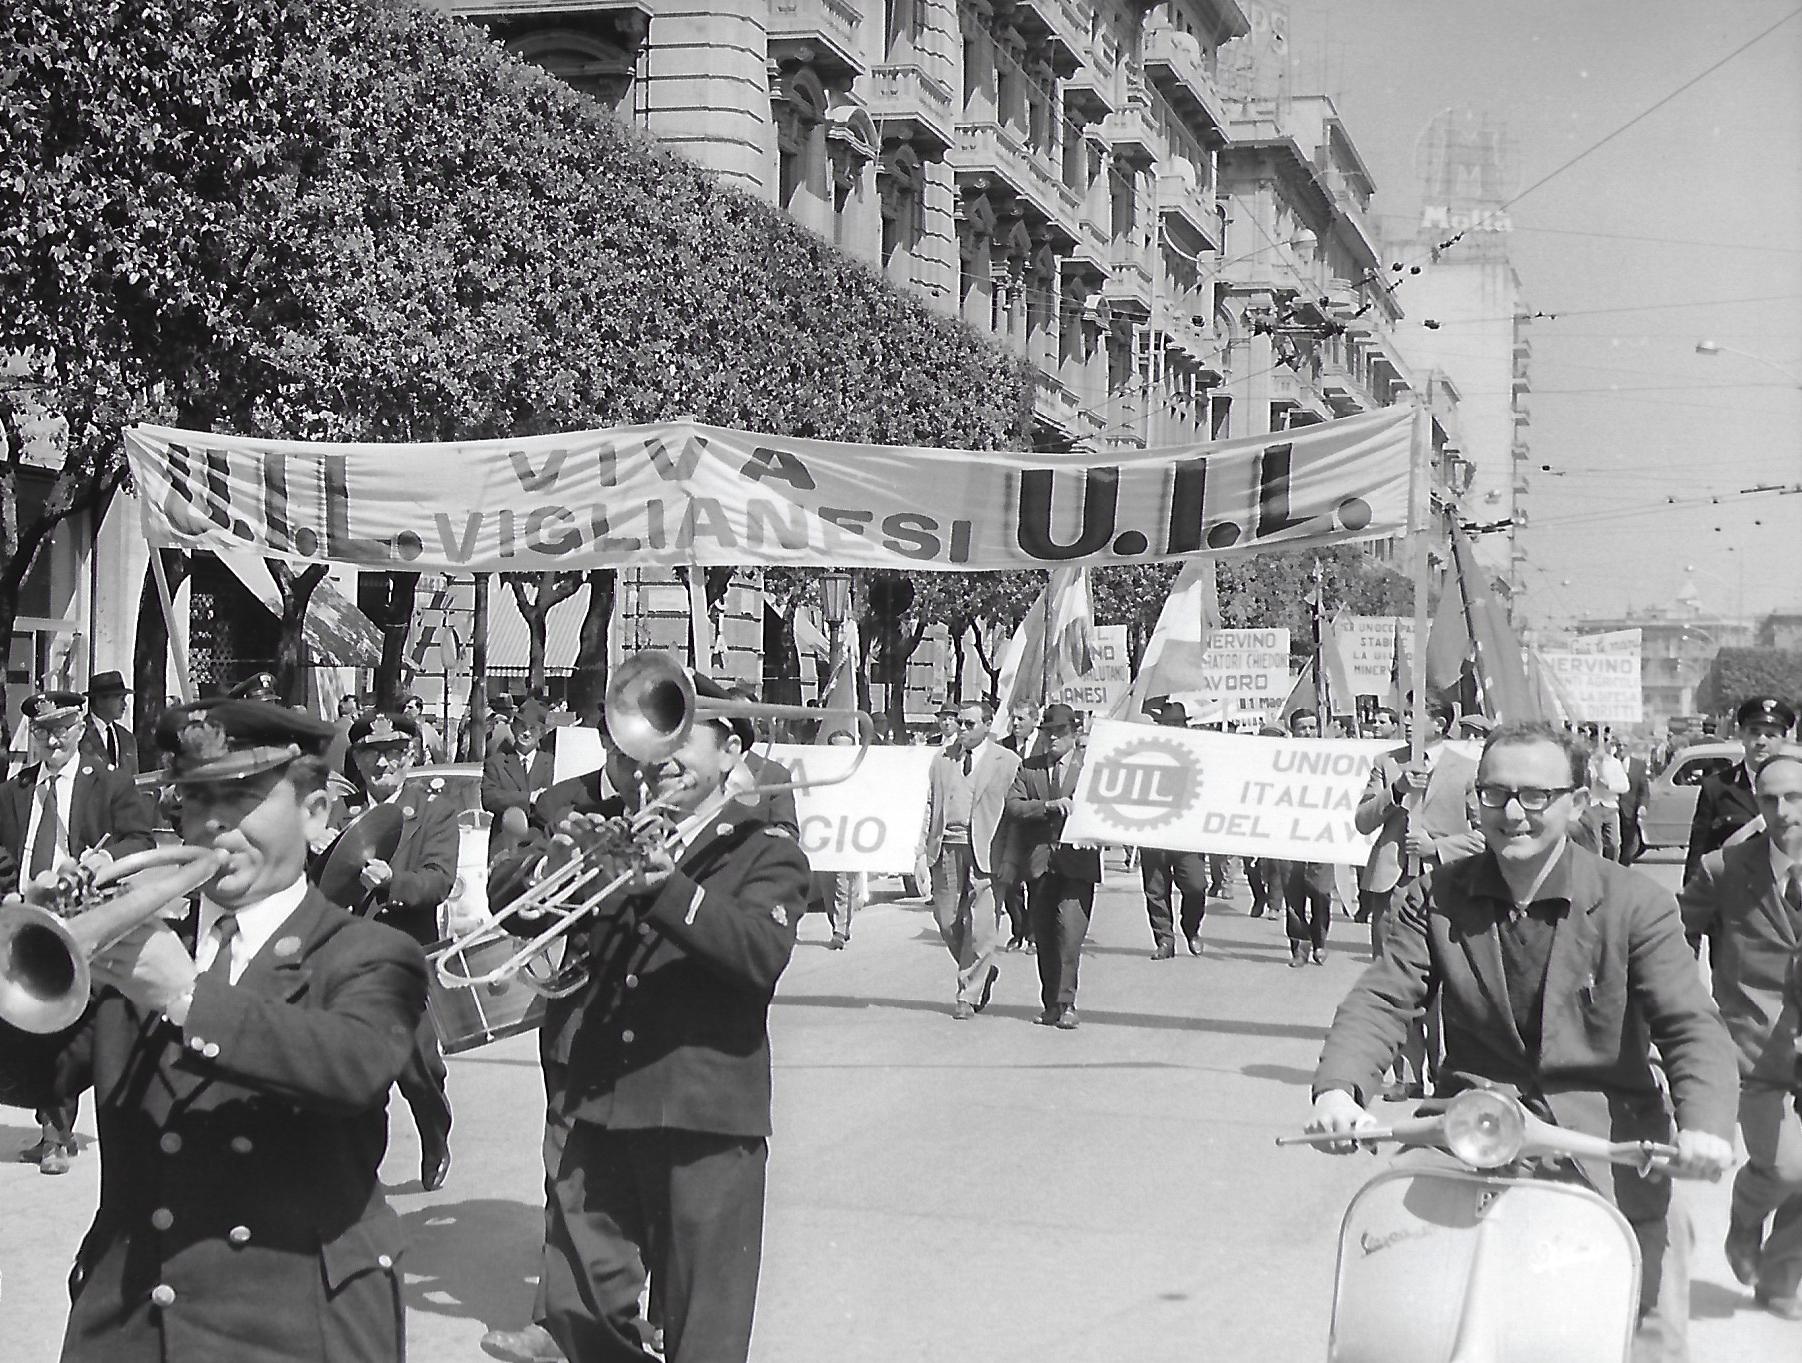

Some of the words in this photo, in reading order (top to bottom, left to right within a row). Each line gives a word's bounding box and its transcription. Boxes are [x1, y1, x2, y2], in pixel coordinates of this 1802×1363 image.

[509, 435, 816, 491] VIVA
[163, 441, 424, 562] U.I.L.
[1017, 442, 1373, 561] U.I.L.
[434, 497, 972, 563] VIGLIANESI
[1360, 637, 1408, 648] STABIE
[1050, 686, 1108, 704] LIANESI
[1098, 767, 1174, 802] UIL
[1202, 812, 1271, 840] DEL
[1290, 817, 1373, 846] LAV
